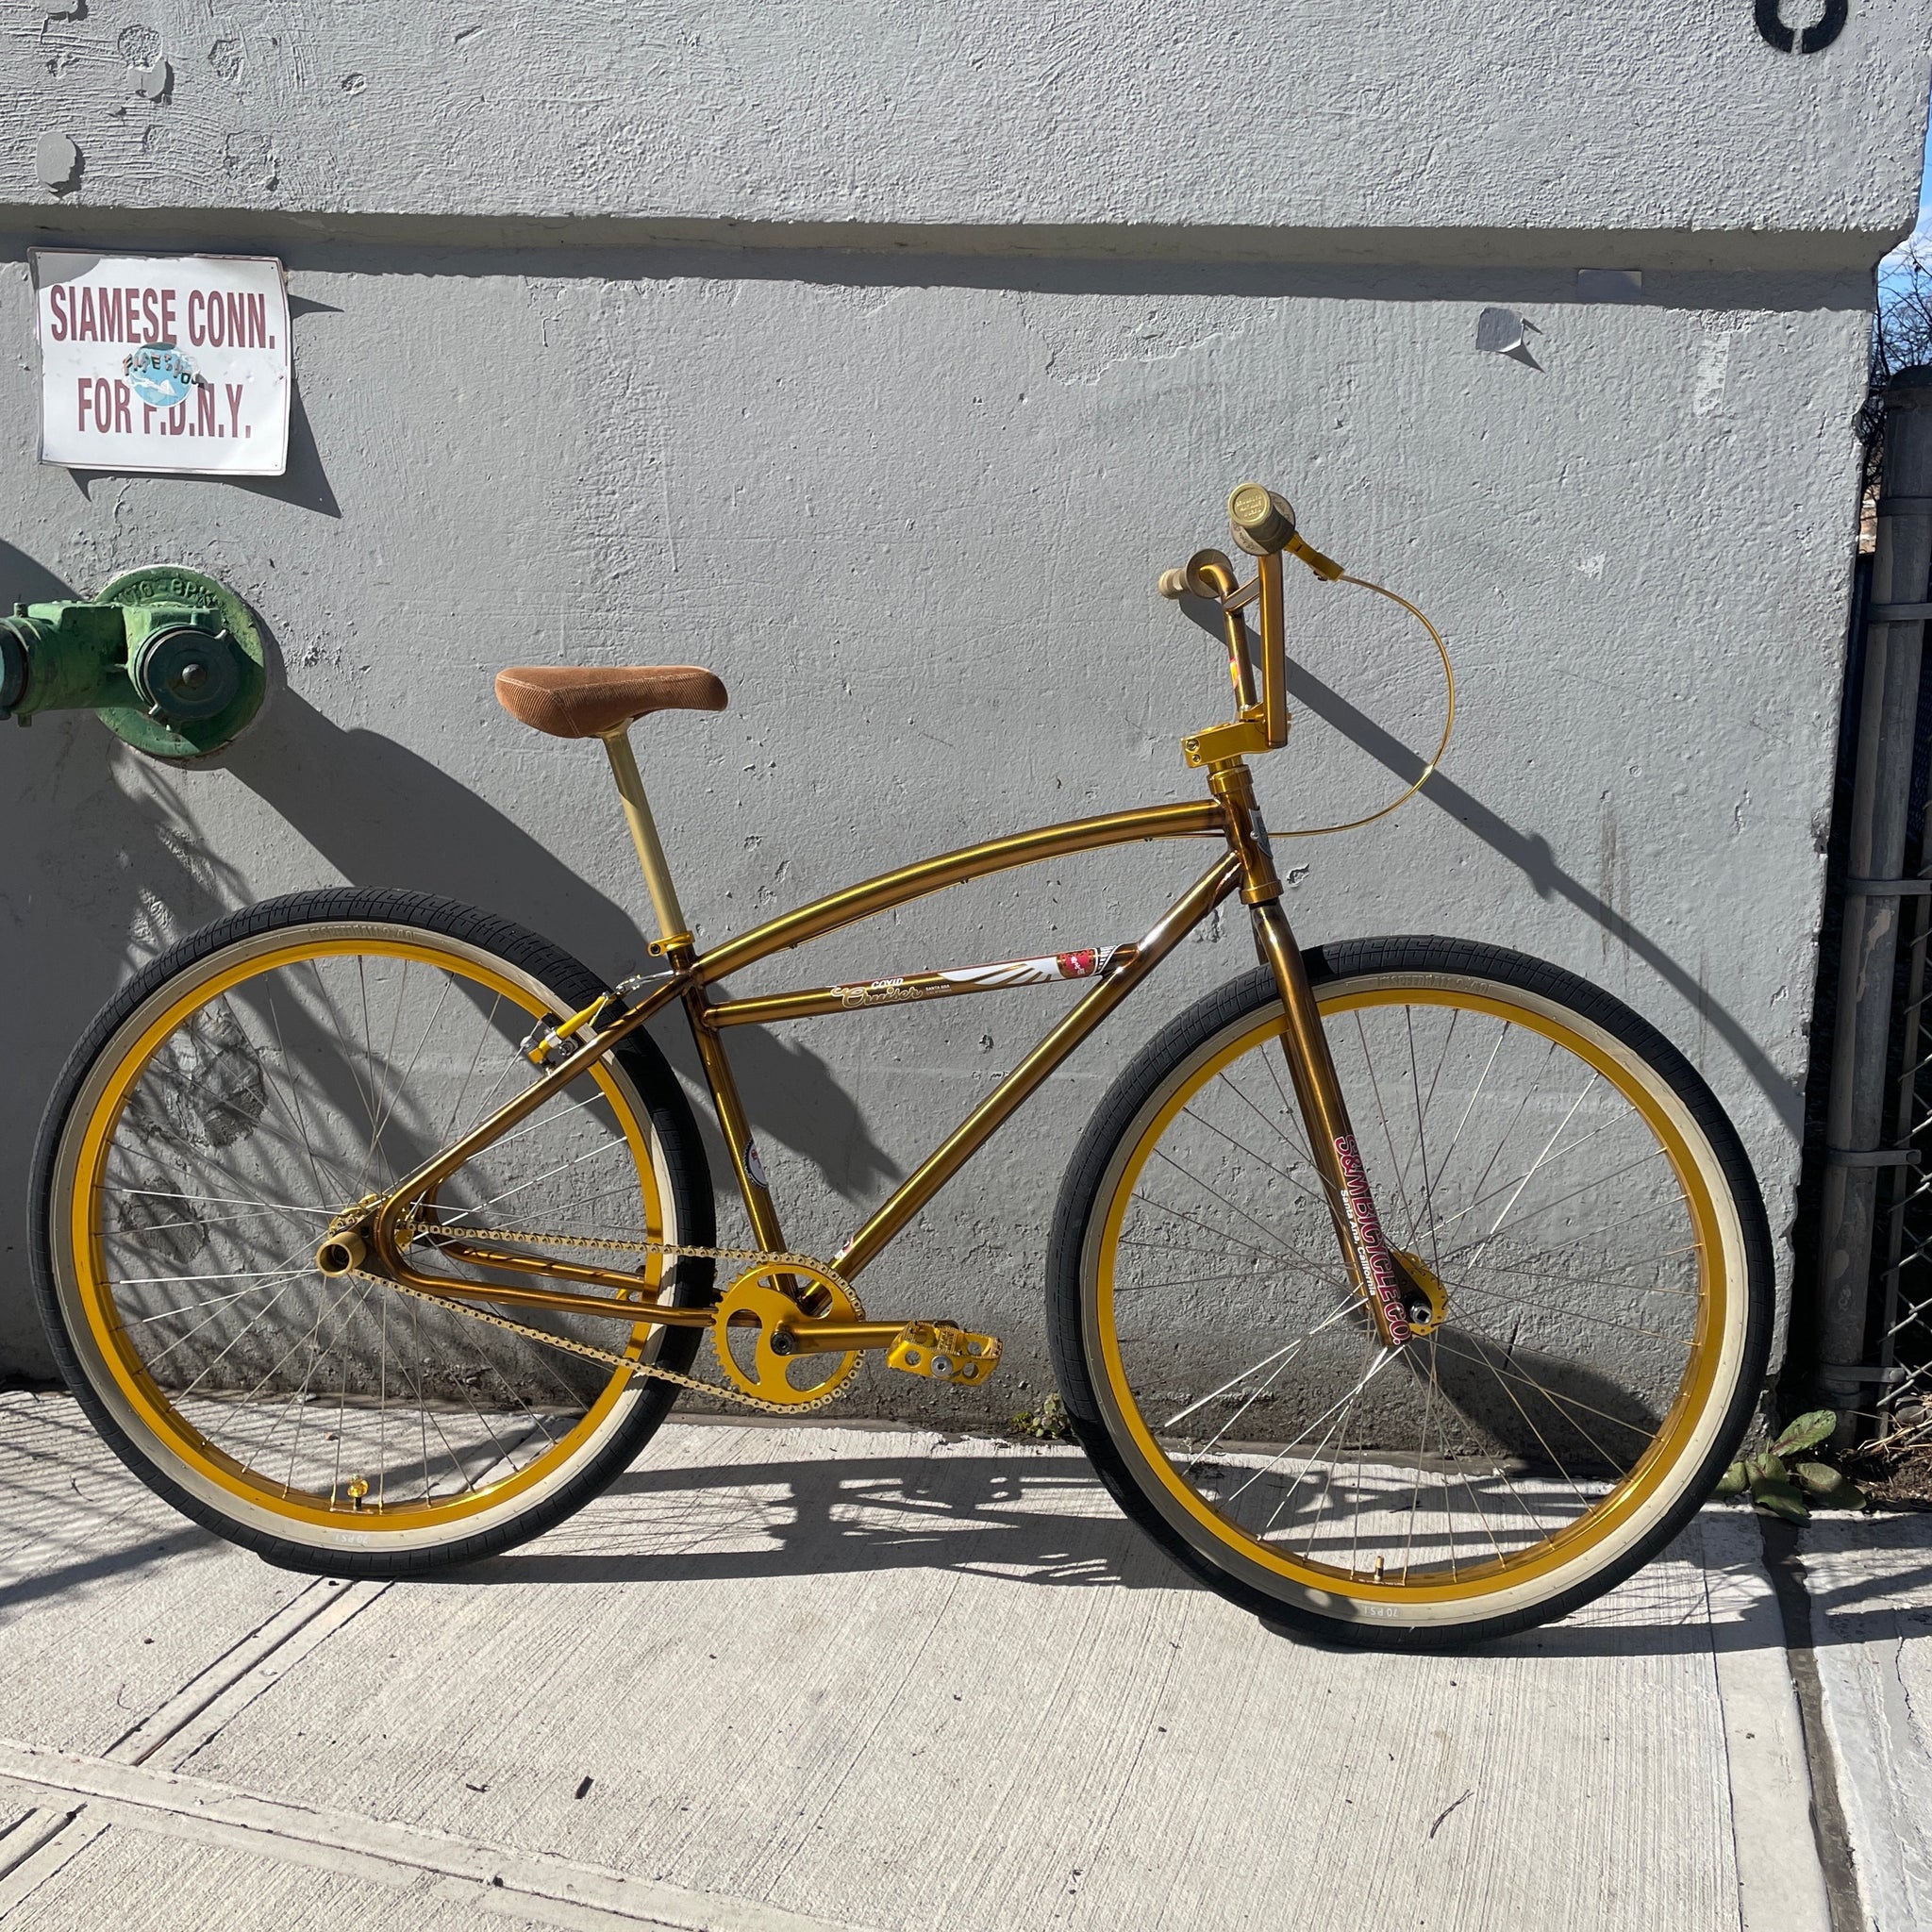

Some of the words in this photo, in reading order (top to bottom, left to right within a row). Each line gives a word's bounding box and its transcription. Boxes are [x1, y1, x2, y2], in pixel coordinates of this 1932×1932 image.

[50, 284, 177, 344] SIAMESE
[188, 290, 276, 349] CONN.
[77, 377, 132, 434] FOR
[830, 986, 924, 1008] Cruiser
[871, 978, 904, 991] COVID
[1335, 1135, 1368, 1195] S&M
[1353, 1197, 1402, 1302] BICYCLE
[1383, 1302, 1411, 1346] CO.
[1341, 1190, 1353, 1222] Santa
[1349, 1221, 1360, 1244] Ana,
[1357, 1246, 1375, 1296] California
